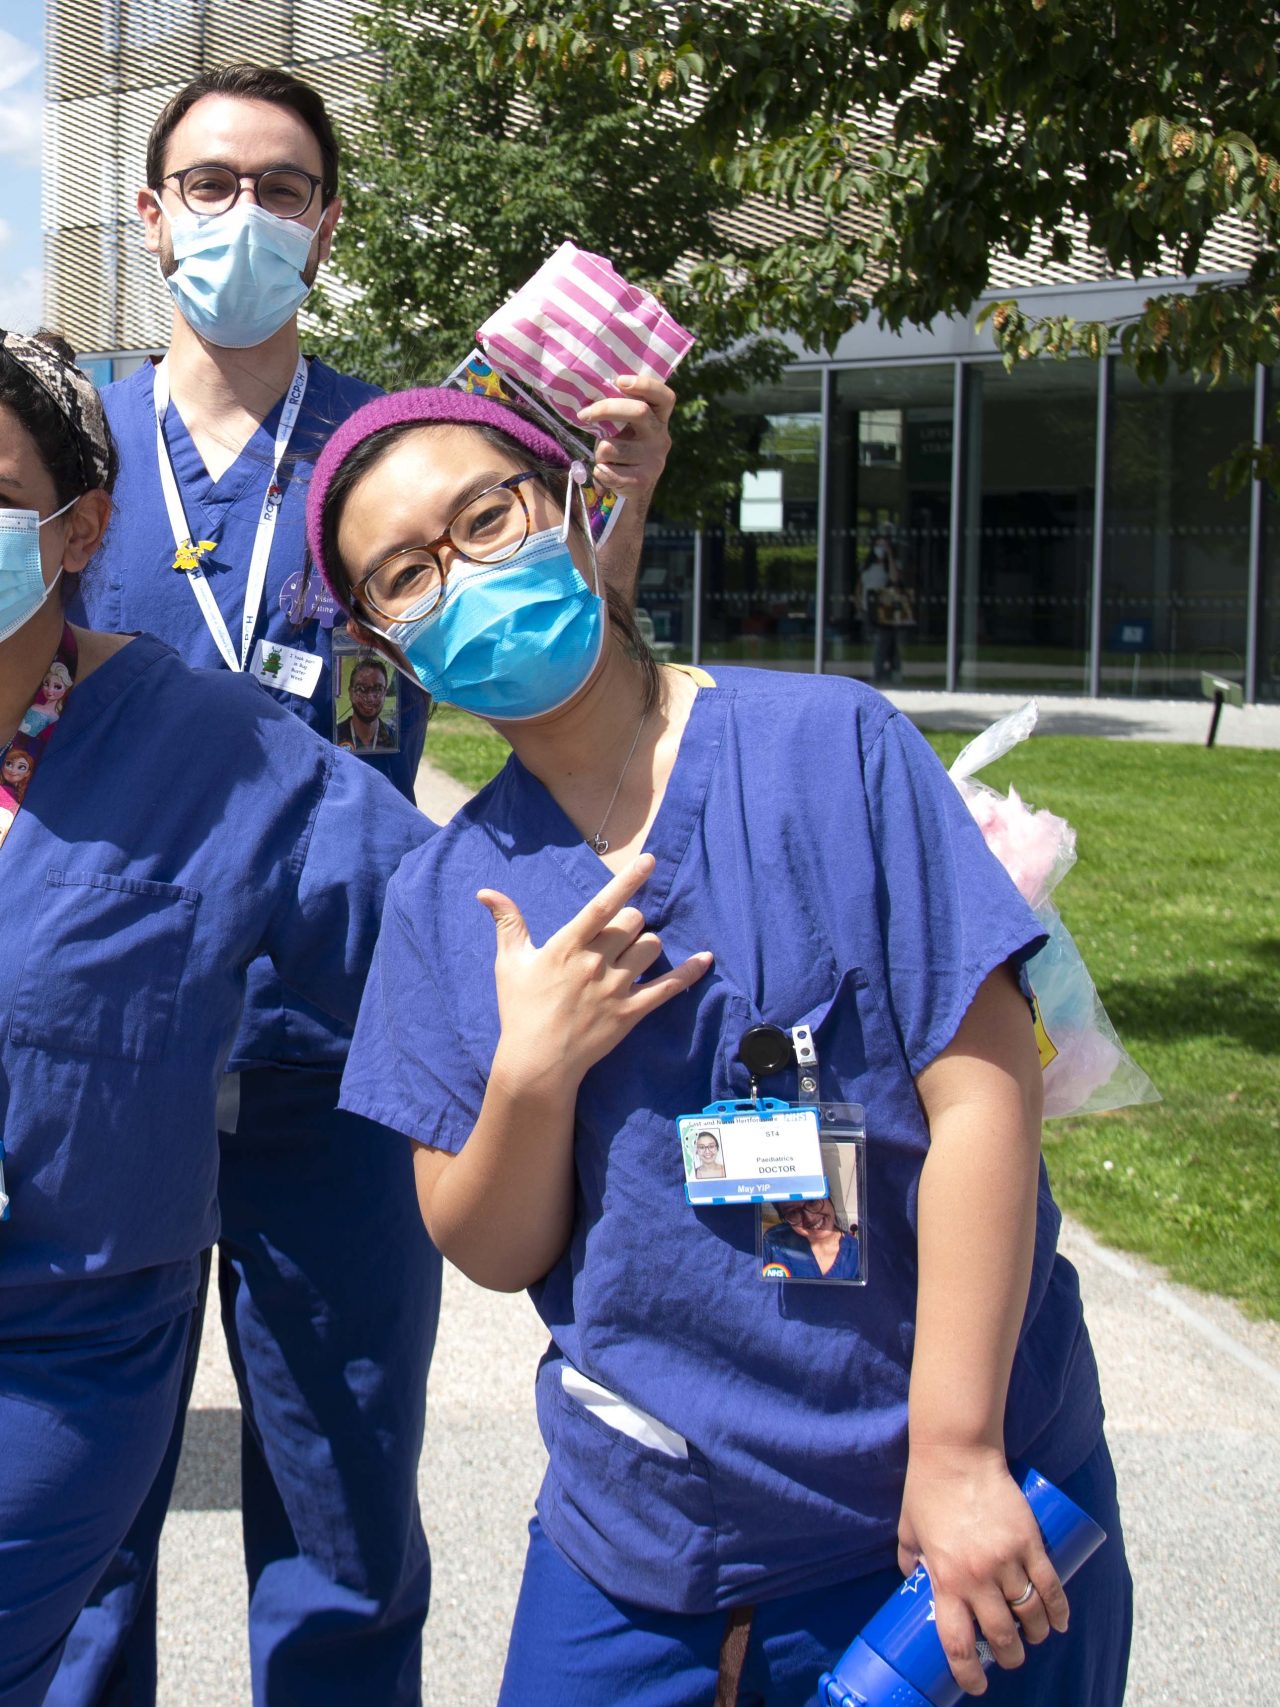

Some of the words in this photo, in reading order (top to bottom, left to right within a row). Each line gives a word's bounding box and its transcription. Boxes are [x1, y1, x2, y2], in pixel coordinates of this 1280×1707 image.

[289, 372, 305, 406] RCPCH
[765, 1130, 780, 1138] ST4
[756, 1155, 794, 1163] Paediatrics
[758, 1164, 796, 1174] DOCTOR
[737, 1184, 755, 1193] May
[756, 1183, 771, 1192] YIP
[767, 1269, 784, 1277] NHS
